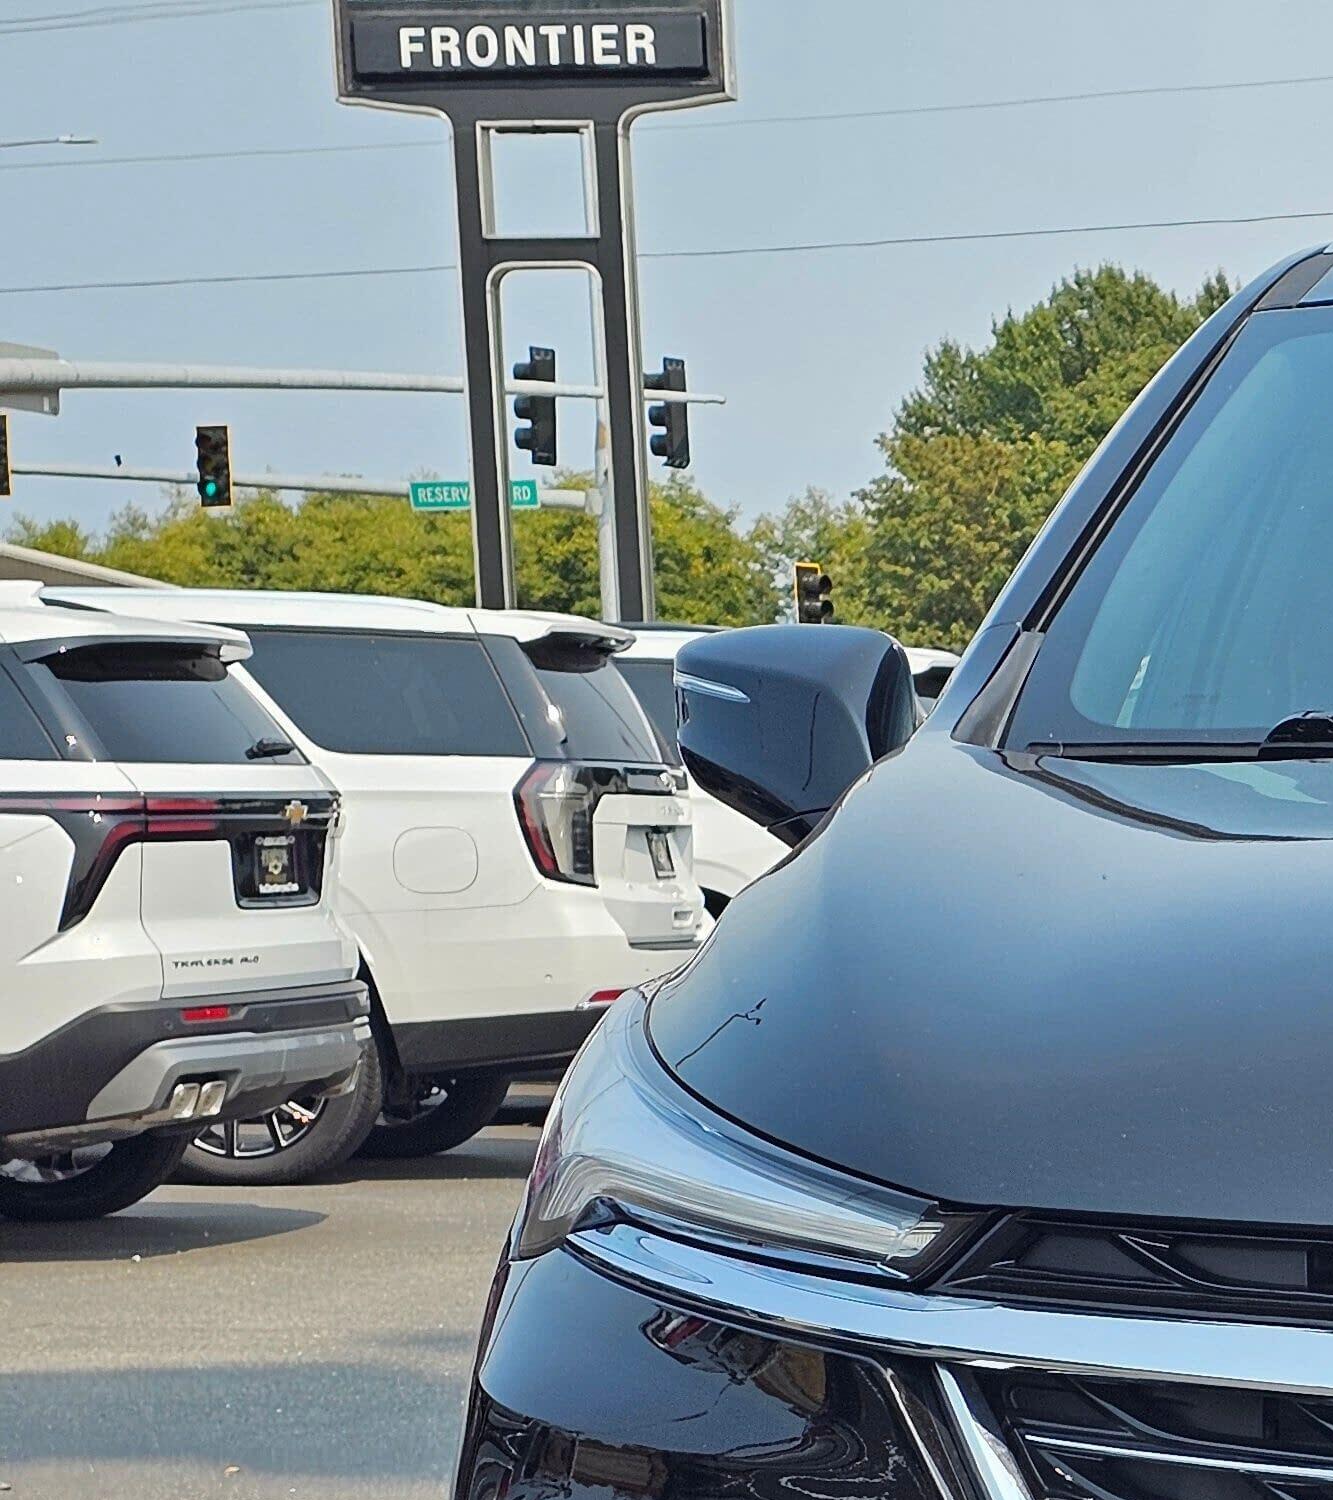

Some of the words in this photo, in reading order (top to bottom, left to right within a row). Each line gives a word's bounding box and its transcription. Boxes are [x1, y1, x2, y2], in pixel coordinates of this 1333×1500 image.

[399, 24, 656, 69] FRONTIER
[417, 486, 469, 503] RESERV
[512, 485, 531, 501] RD
